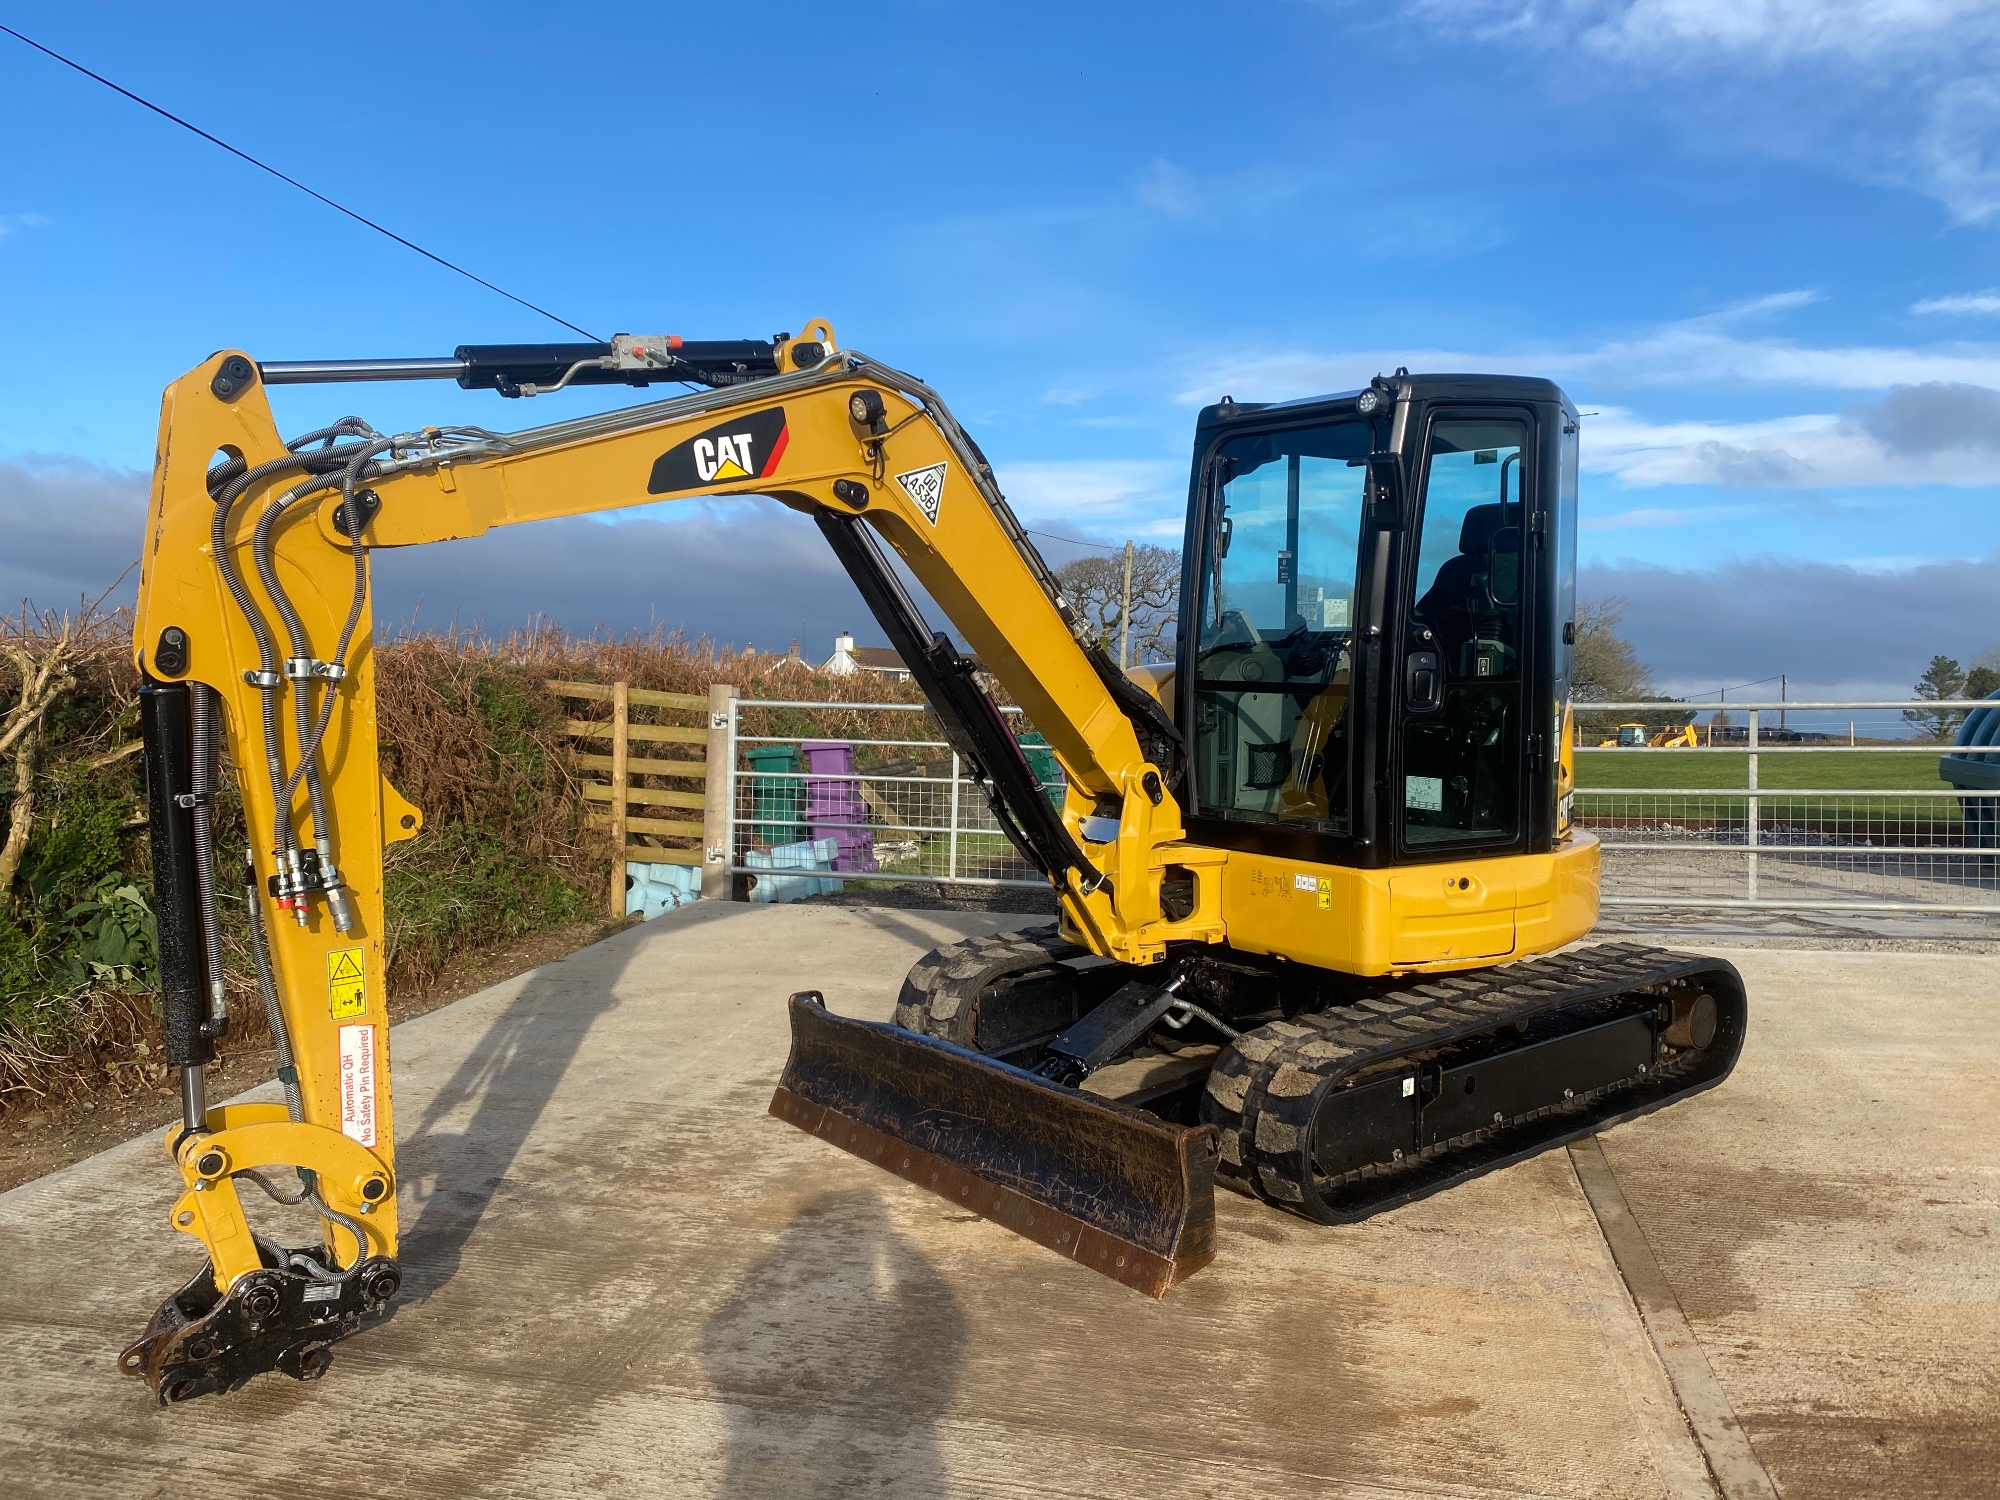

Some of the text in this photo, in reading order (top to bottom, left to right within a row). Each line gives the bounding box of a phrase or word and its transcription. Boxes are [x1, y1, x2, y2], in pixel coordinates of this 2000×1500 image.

[693, 433, 753, 481] CAT
[342, 1054, 355, 1122] Automatic QH
[358, 1029, 373, 1143] No Safety Pin Required
